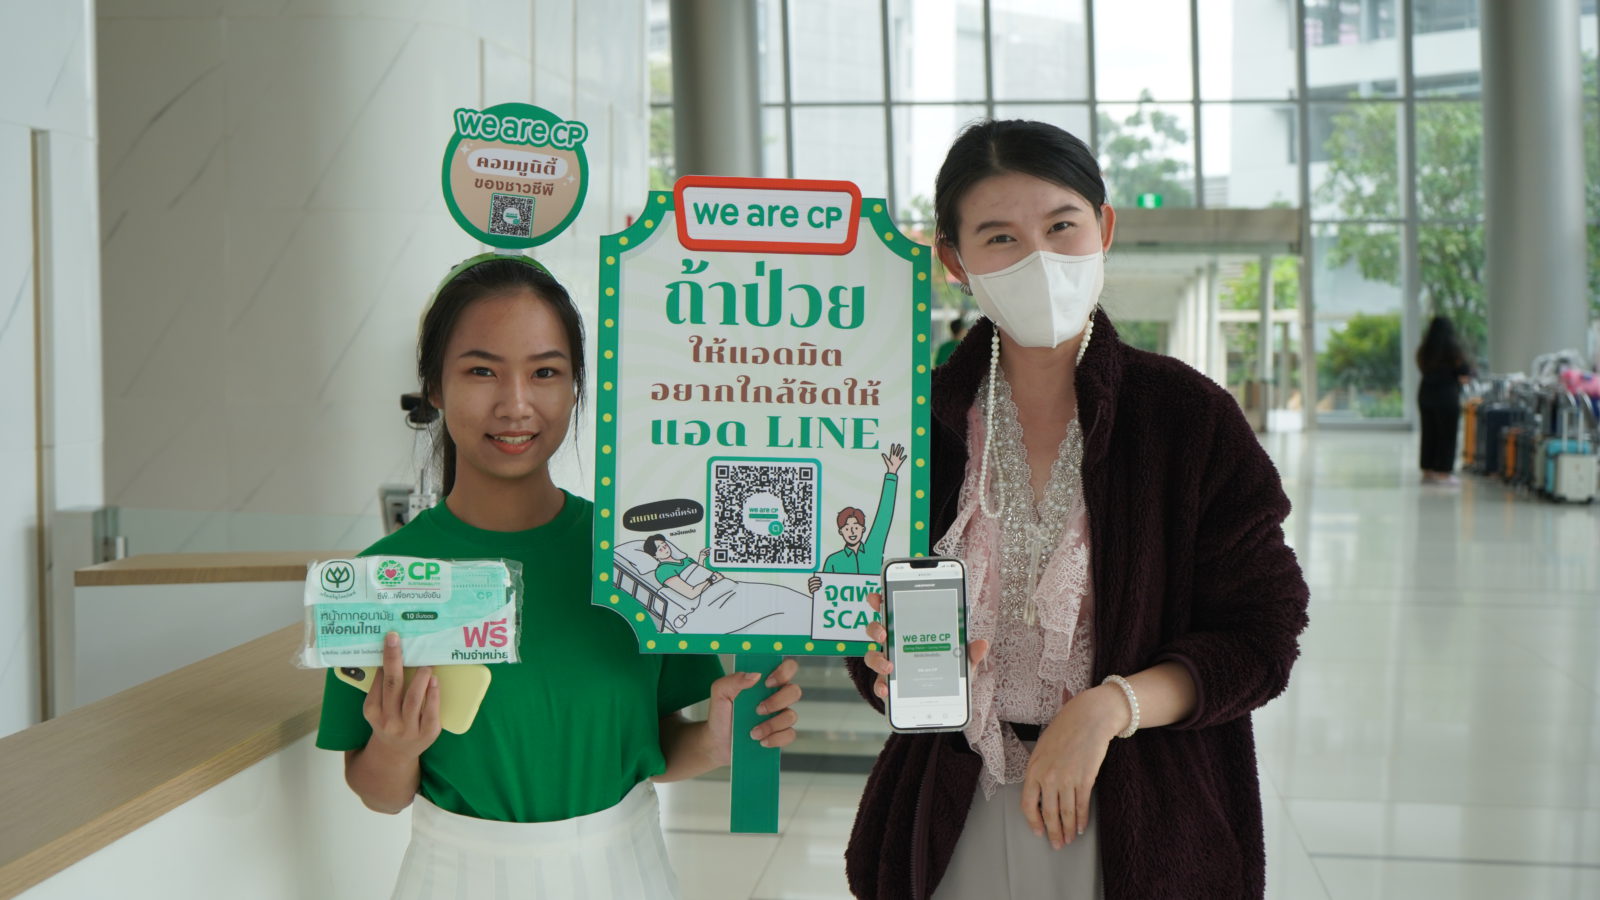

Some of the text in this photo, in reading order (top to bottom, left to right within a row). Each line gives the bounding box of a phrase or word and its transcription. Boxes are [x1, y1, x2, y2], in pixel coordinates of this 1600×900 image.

[457, 111, 584, 147] we are CP
[476, 157, 557, 176] คอมมูนิตี้
[474, 178, 554, 196] ของชาวซีพี
[693, 202, 842, 229] we are CP
[665, 259, 865, 330] ถ้าป่วย
[689, 335, 843, 367] ให้แอดมิต
[651, 375, 881, 406] อยากใกล้ชิดให้
[651, 416, 880, 450] แอด LINE
[408, 562, 440, 581] CP
[476, 591, 493, 600] CP
[825, 581, 882, 607] จุดพั
[321, 609, 394, 622] หน้ากากอนามัย
[321, 621, 381, 635] เพื่อคนไทย
[463, 618, 508, 648] ฟรี
[902, 633, 951, 642] we are CP
[452, 649, 508, 660] ห้ามจำหน่าย
